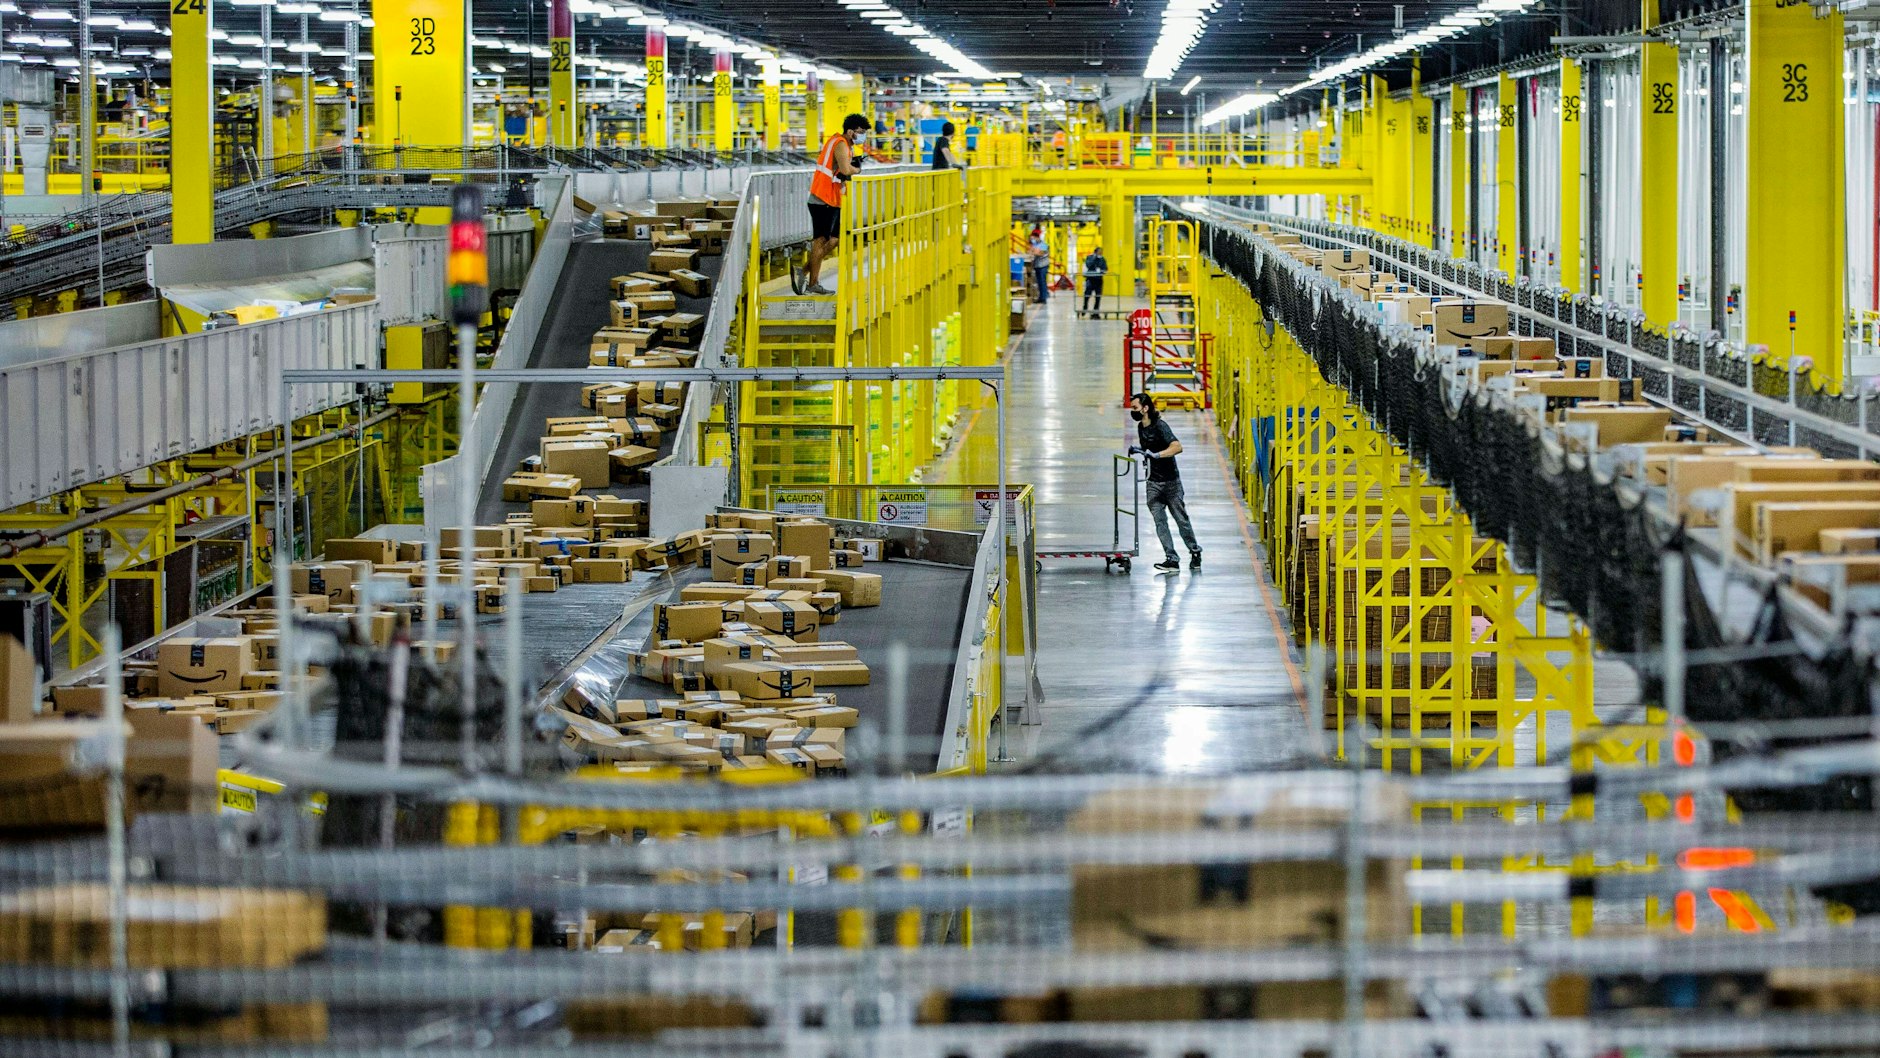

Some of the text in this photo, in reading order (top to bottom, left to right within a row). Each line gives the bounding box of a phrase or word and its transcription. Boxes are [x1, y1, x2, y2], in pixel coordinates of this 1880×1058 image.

[173, 0, 207, 15] 24
[411, 18, 436, 36] 3D
[411, 37, 436, 55] 23
[552, 42, 571, 56] 3D
[552, 57, 571, 71] 22
[648, 60, 664, 73] 3D
[1782, 63, 1808, 82] 3C
[648, 73, 664, 85] 21
[716, 74, 731, 85] 3D
[717, 86, 731, 96] 20
[1652, 83, 1673, 98] 3C
[1783, 83, 1809, 102] 23
[767, 96, 778, 105] 19
[1563, 95, 1580, 108] 3C
[1653, 99, 1674, 114] 22
[837, 105, 848, 113] 17
[1501, 105, 1514, 116] 3C
[1417, 116, 1428, 125] 3C
[1453, 111, 1465, 120] 3C
[1501, 116, 1514, 127] 20
[1564, 109, 1579, 122] 21
[1387, 128, 1397, 136] 17
[1417, 125, 1428, 135] 18
[1454, 121, 1465, 131] 19
[786, 494, 823, 502] CAUTION
[888, 493, 925, 501] CAUTION
[229, 791, 255, 810] CAUTION
